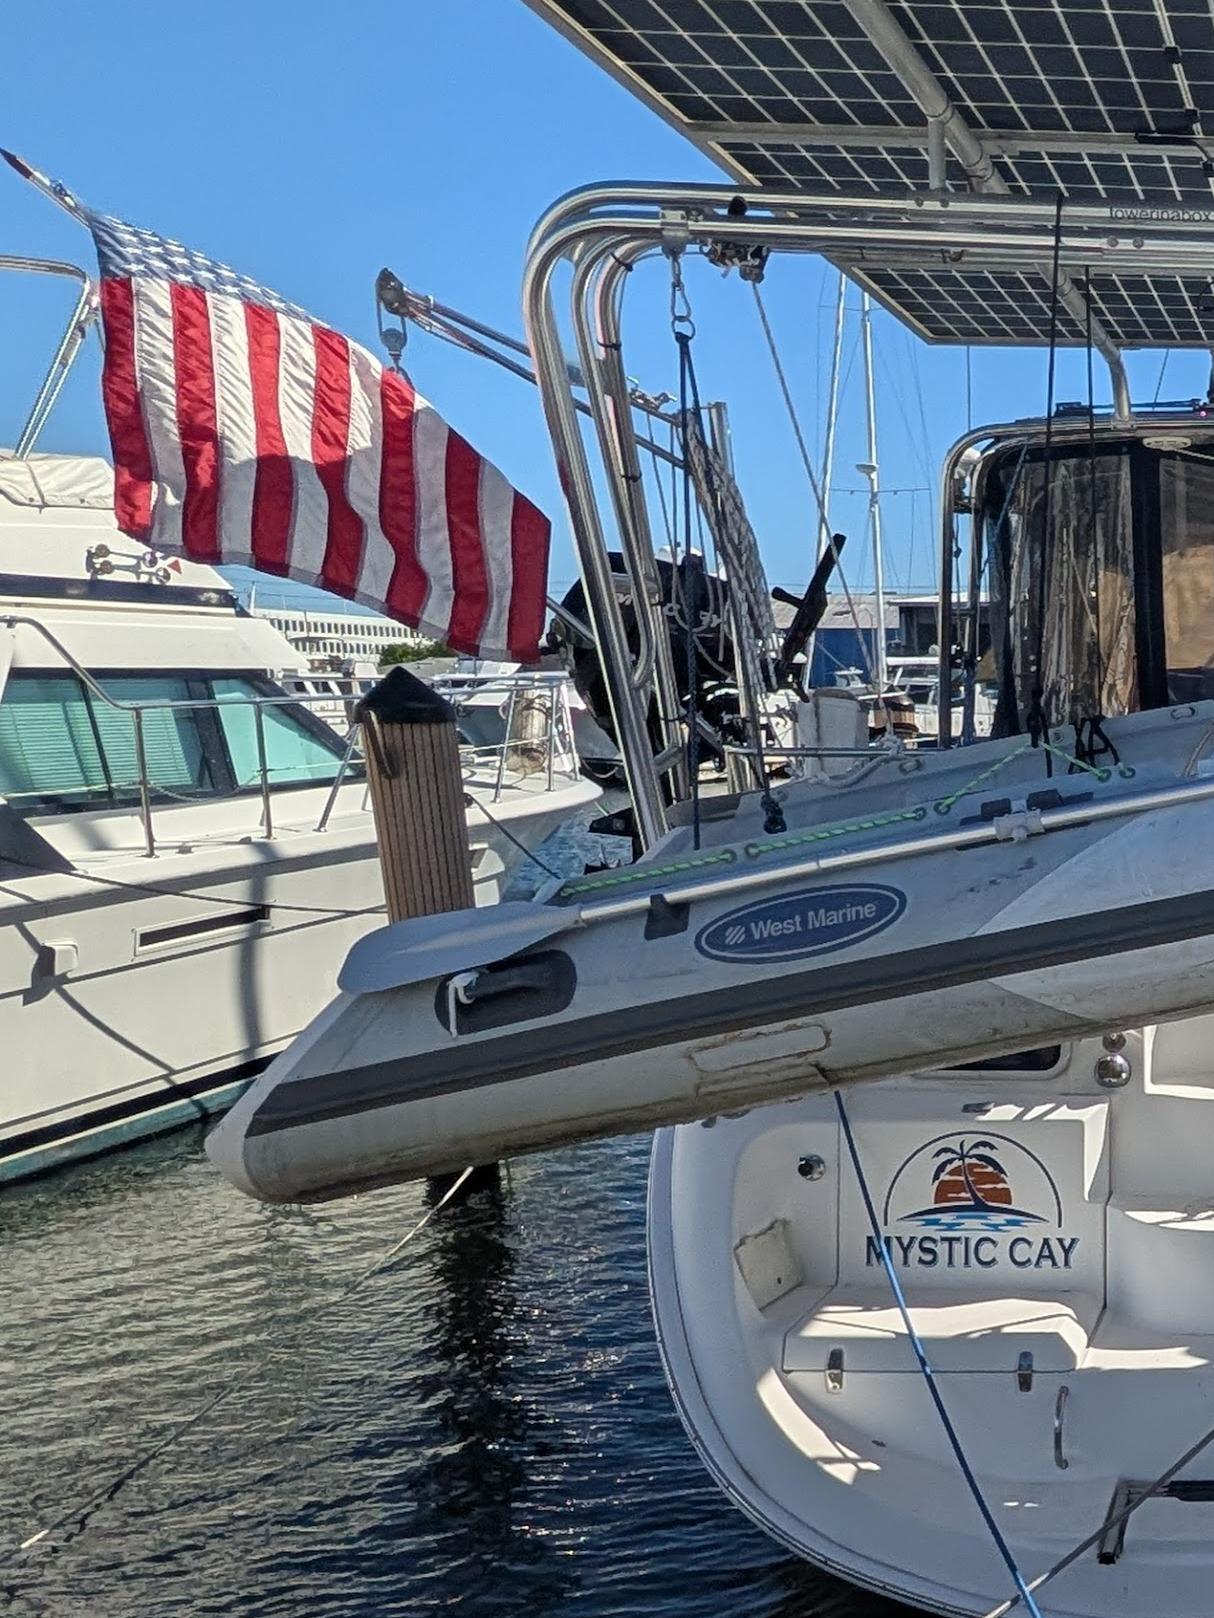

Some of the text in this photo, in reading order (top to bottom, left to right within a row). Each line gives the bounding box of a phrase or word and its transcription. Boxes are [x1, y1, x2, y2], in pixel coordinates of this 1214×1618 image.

[750, 902, 877, 940] West Marine
[865, 1235, 1080, 1269] MYSTIC CAY
